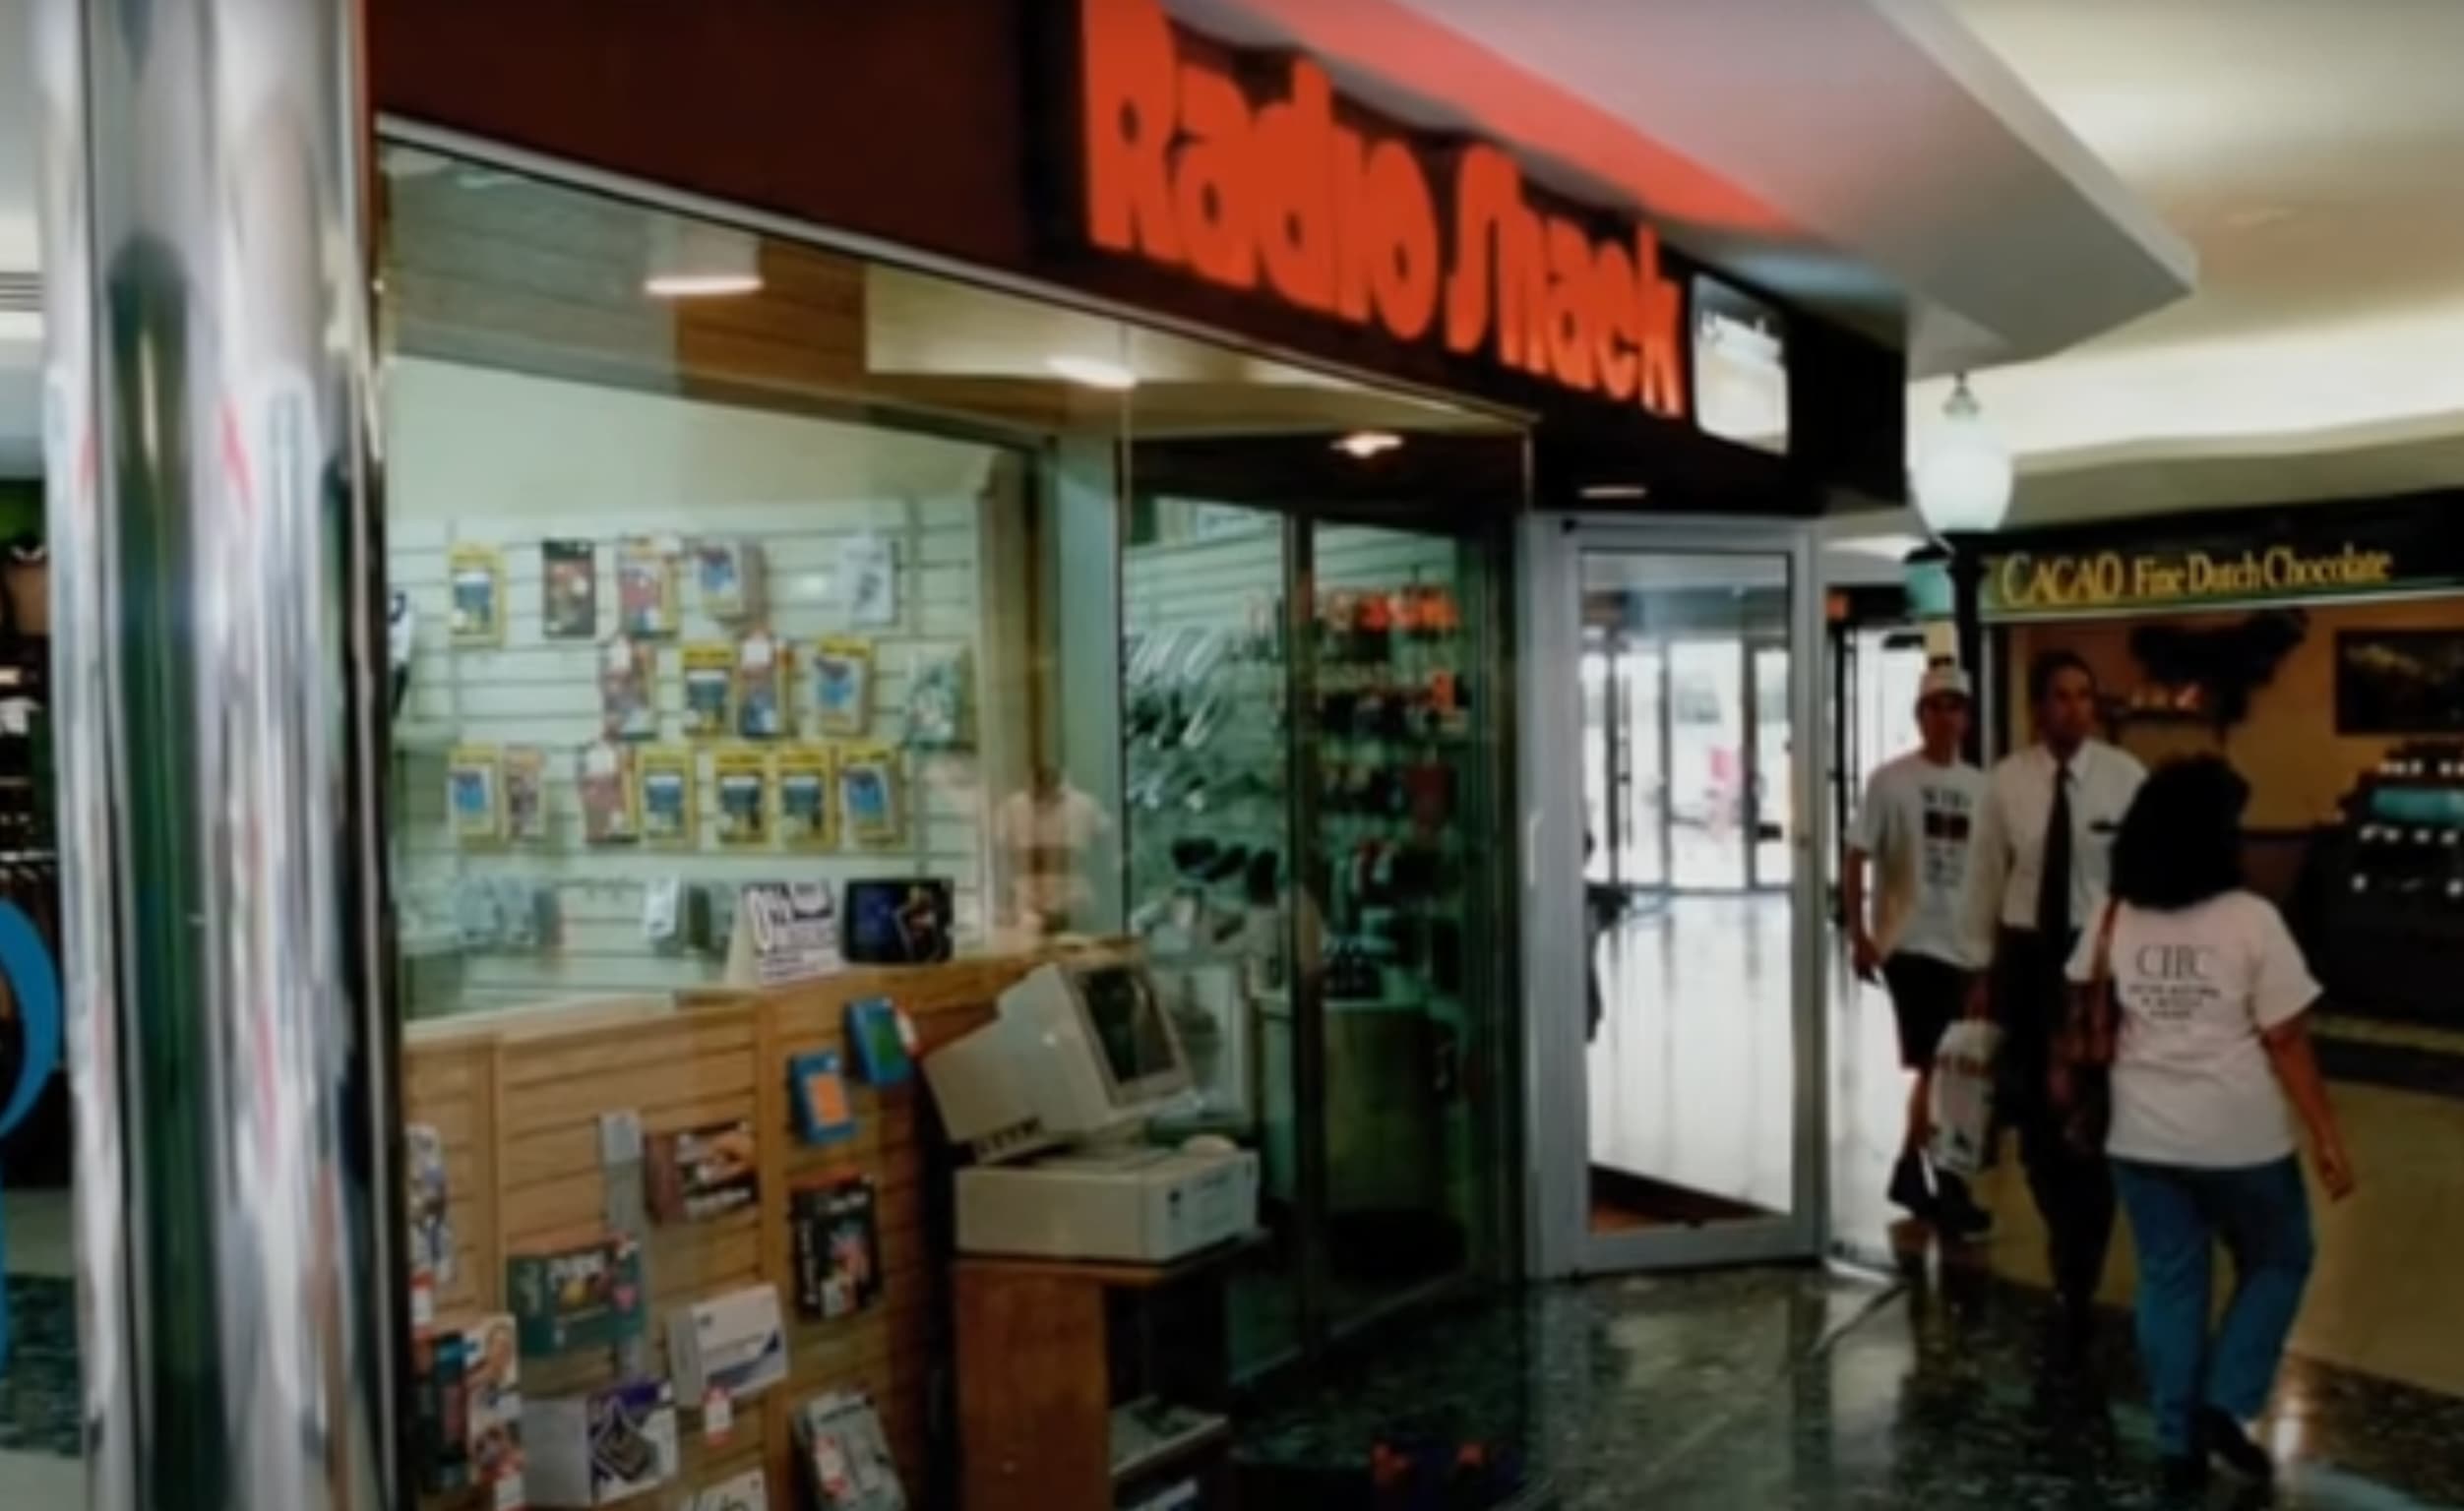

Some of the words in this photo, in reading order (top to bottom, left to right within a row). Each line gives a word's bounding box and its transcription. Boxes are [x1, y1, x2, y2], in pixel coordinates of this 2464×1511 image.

[1082, 0, 1438, 341] Radio
[1445, 145, 1681, 418] Shack
[2002, 552, 2123, 605] CACAO
[2264, 542, 2392, 587] Chocolate
